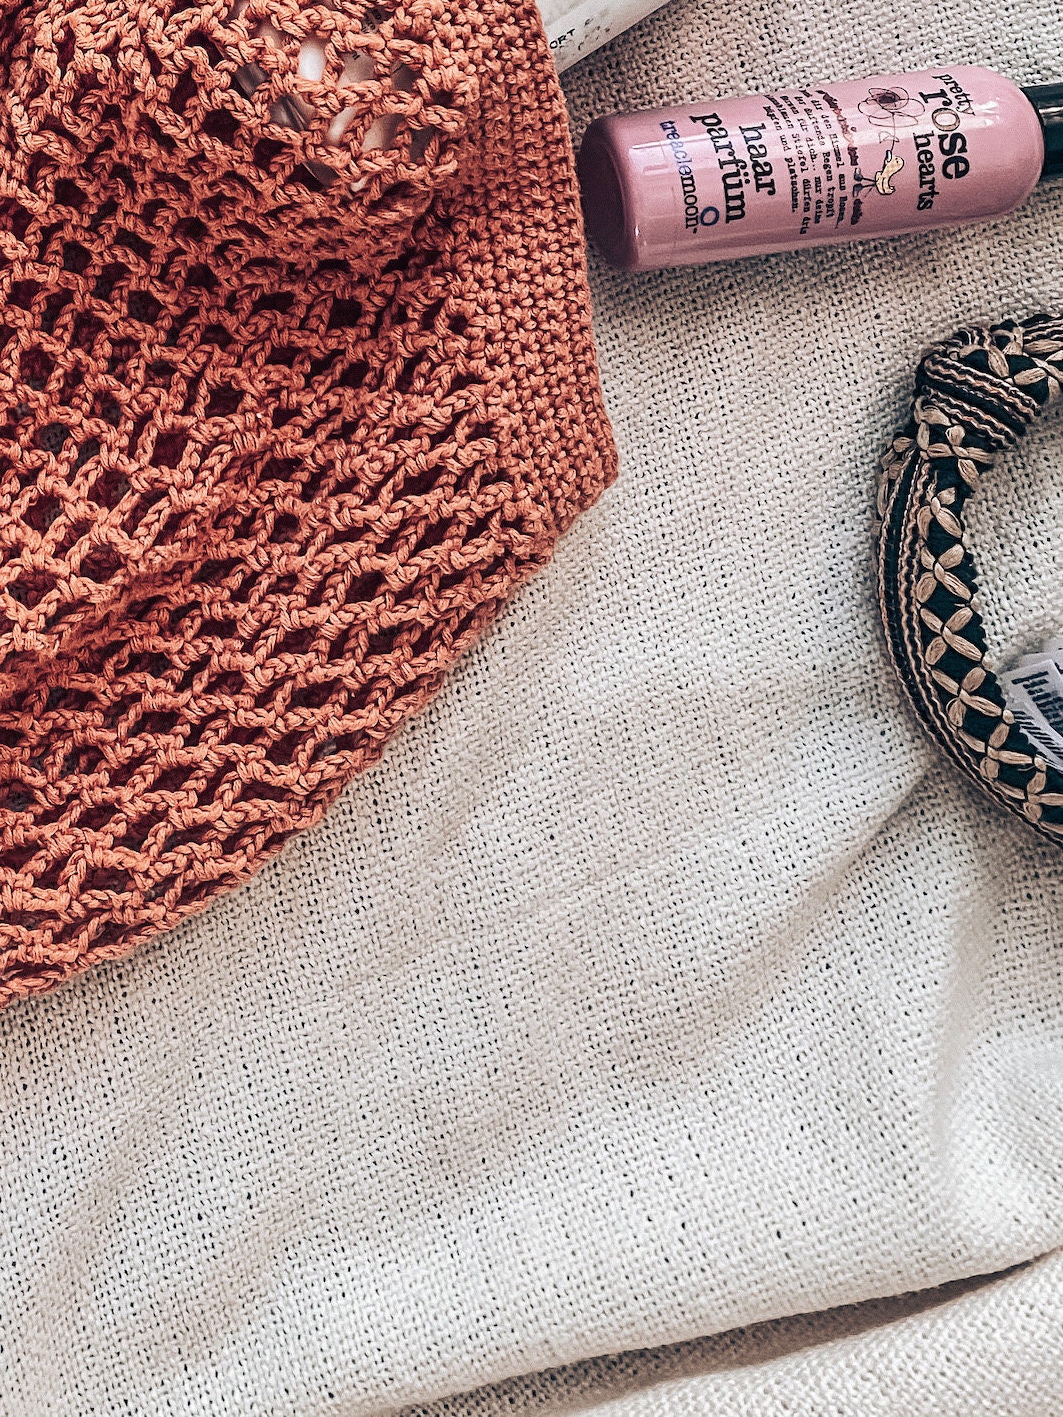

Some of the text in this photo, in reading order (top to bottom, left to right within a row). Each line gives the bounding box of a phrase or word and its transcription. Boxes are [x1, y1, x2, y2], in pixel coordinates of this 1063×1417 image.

[931, 73, 976, 117] pretty
[688, 112, 751, 224] parfüm
[738, 123, 776, 196] haar
[779, 134, 792, 152] und
[822, 151, 833, 182] Regen
[912, 130, 940, 211] hearts
[917, 88, 970, 180] rose
[659, 120, 699, 230] treaclemoon
[792, 133, 809, 174] Stiefel
[802, 178, 812, 213] dürfen
[826, 186, 836, 218] tropft
